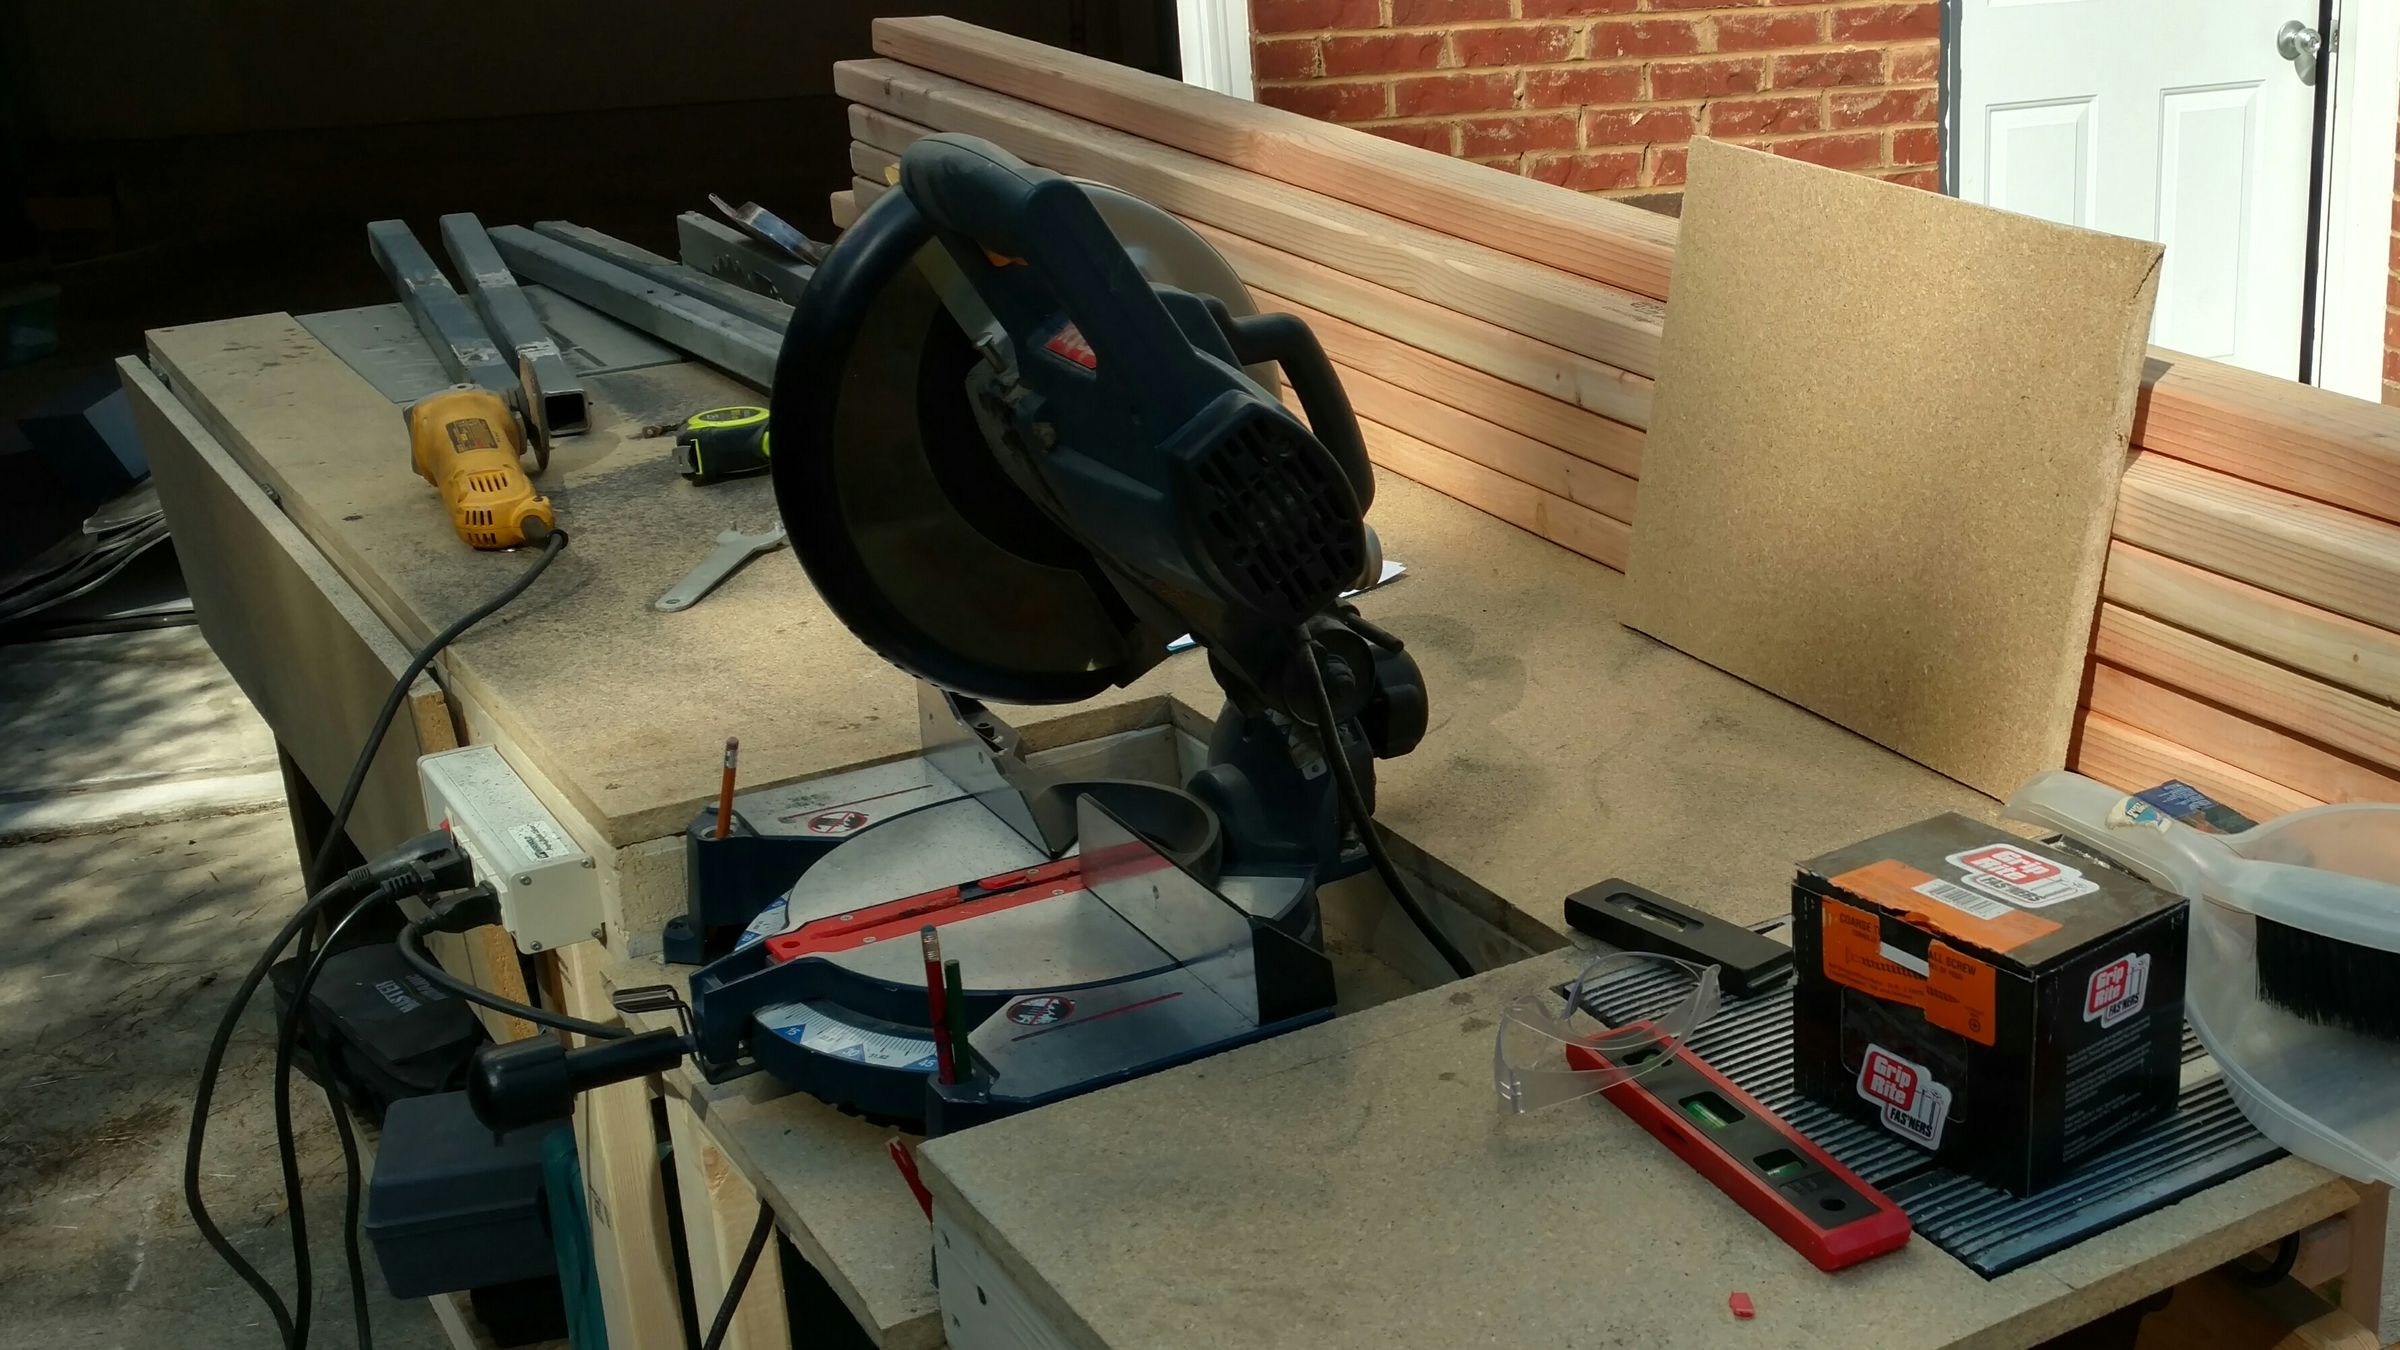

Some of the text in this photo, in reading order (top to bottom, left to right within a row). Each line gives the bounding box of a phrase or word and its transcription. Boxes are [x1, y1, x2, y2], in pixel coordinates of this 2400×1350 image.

[1970, 857, 2028, 880] Rite
[1991, 850, 2050, 874] Grip
[1839, 912, 1872, 931] COARSE
[1945, 955, 1977, 977] SCREW
[2095, 965, 2125, 991] Grip
[375, 979, 422, 1013] MASTER
[2093, 984, 2121, 1009] Rite
[919, 1056, 937, 1068] 45
[1872, 1055, 1912, 1089] Grip
[1870, 1073, 1907, 1105] Rite
